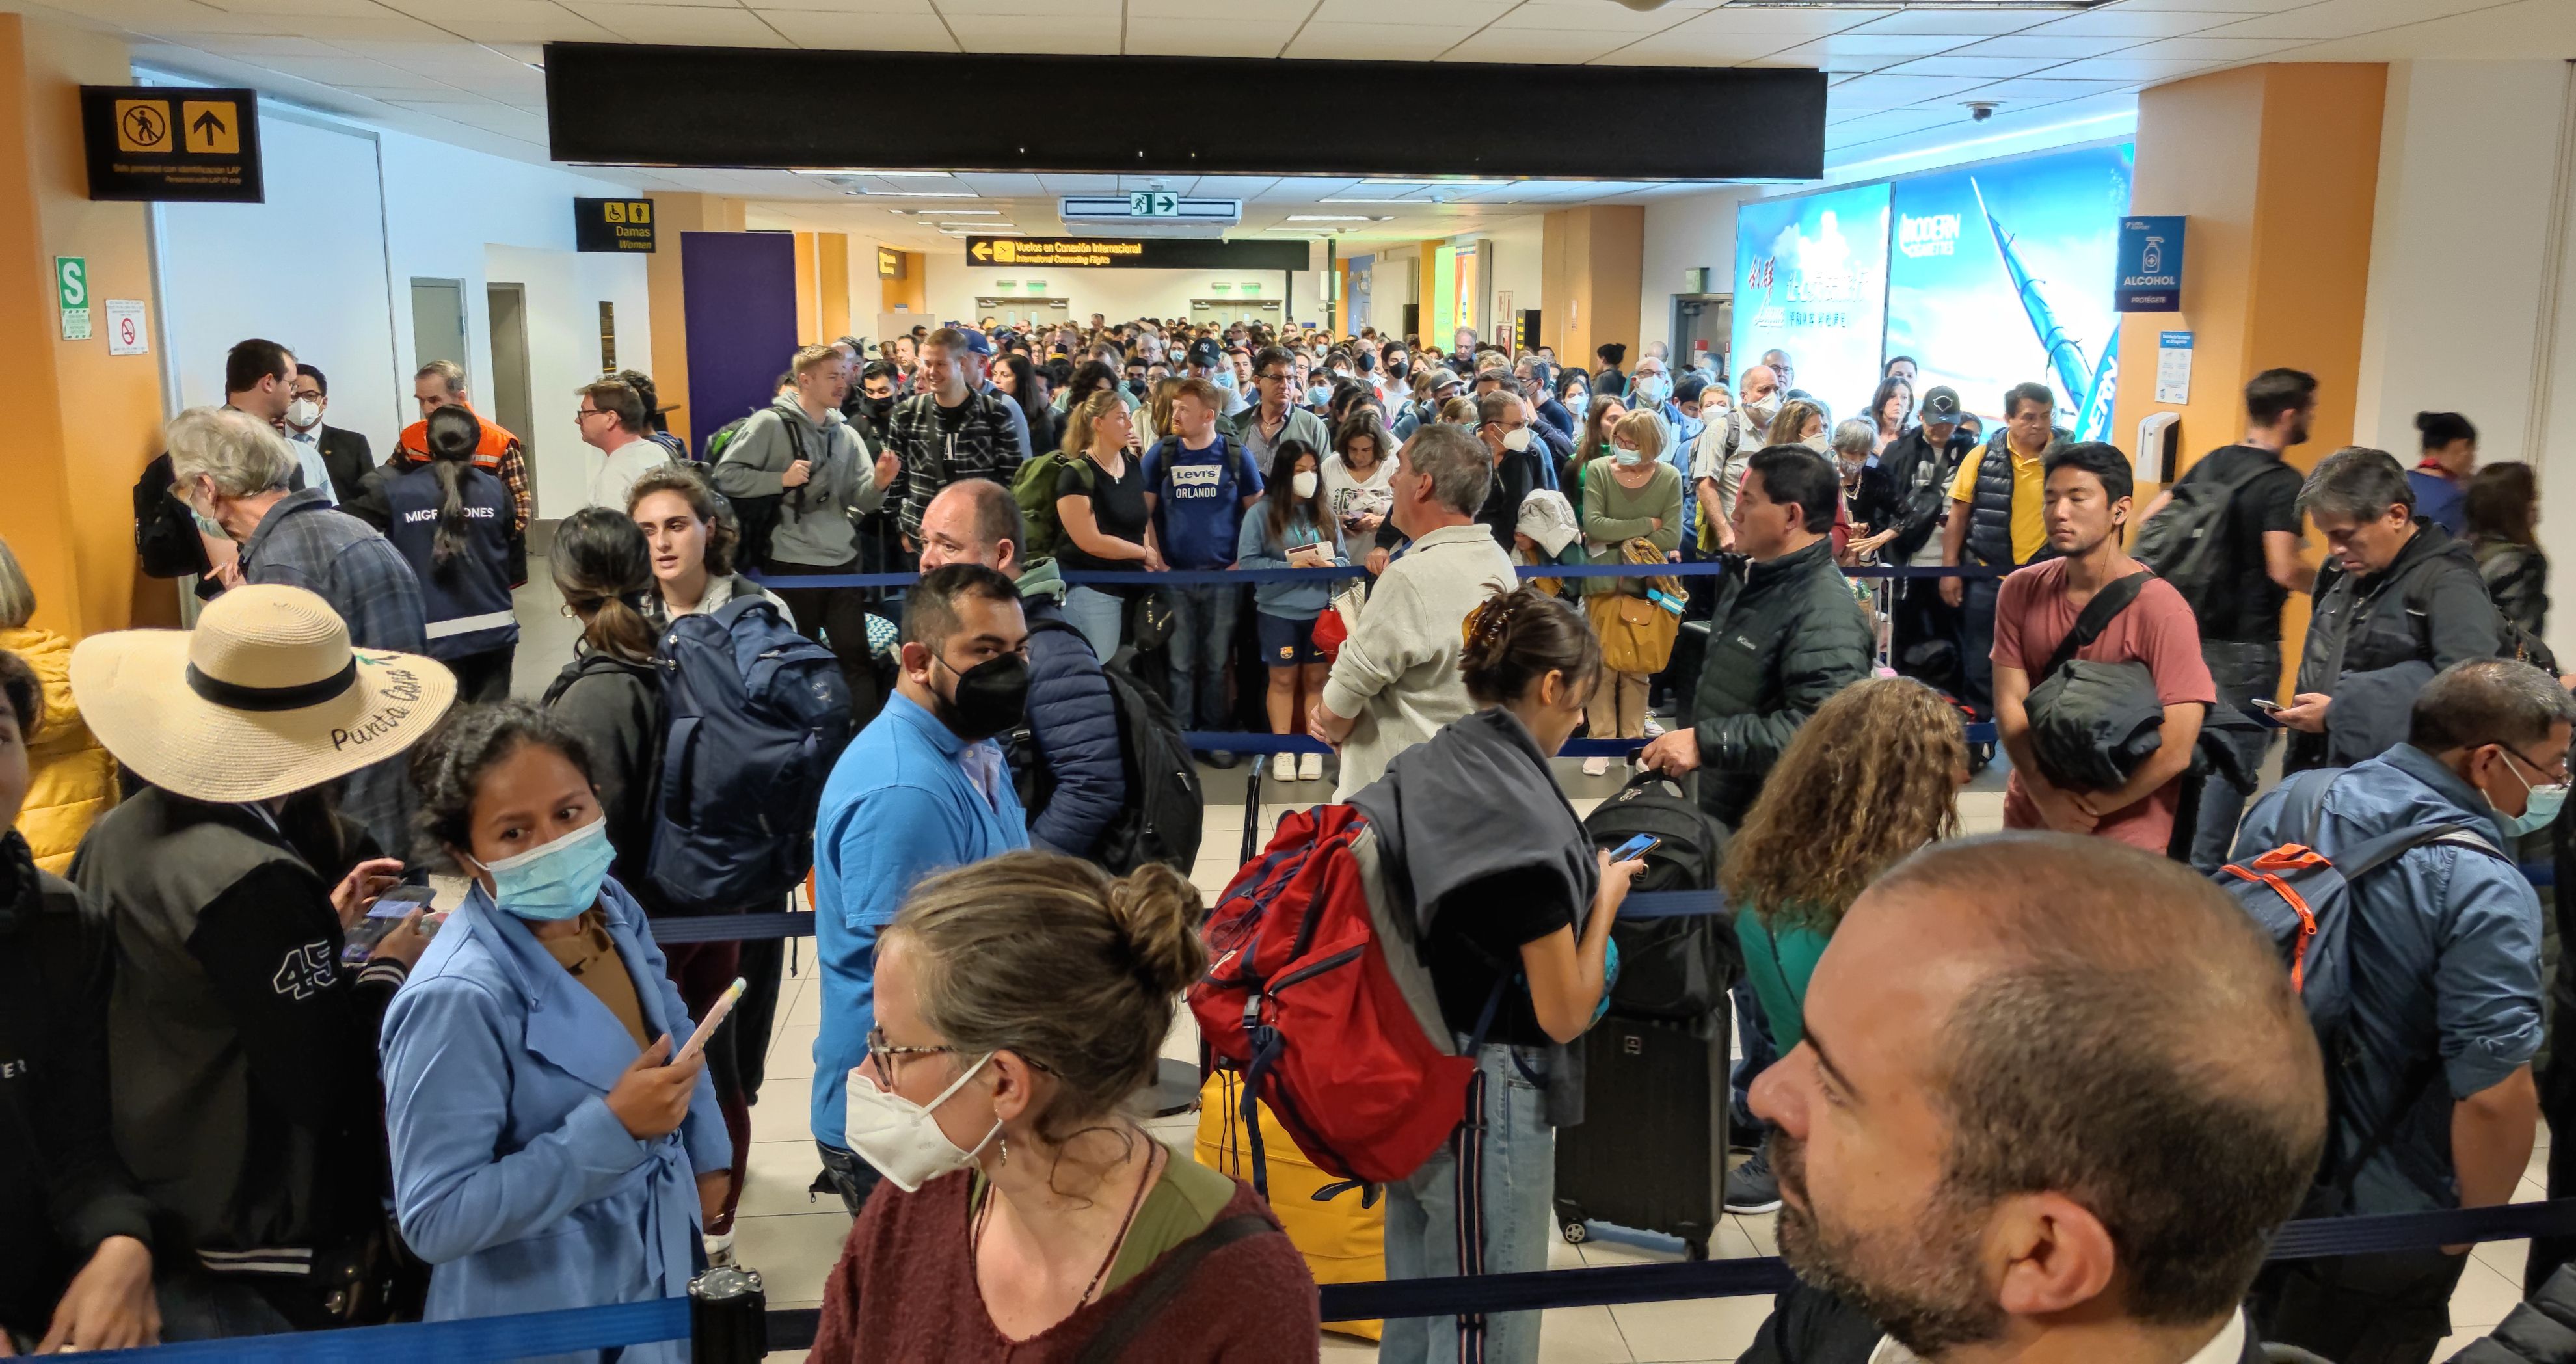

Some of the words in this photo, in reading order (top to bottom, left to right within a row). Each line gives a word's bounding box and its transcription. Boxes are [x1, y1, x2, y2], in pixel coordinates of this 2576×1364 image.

[616, 226, 651, 237] Damas
[619, 240, 651, 249] Women
[1015, 242, 1042, 253] Vuelos
[1043, 244, 1054, 253] en
[1054, 242, 1092, 253] Conexión
[1092, 243, 1142, 254] Internacional
[1015, 254, 1054, 263] International
[1054, 255, 1089, 265] Connecting
[1089, 255, 1110, 265] Flights
[62, 261, 85, 305] S
[2123, 276, 2175, 286] ALCOHOL
[1175, 487, 1216, 499] ORLANDO
[405, 507, 494, 523] MIGRONES
[331, 707, 410, 752] Punta
[273, 939, 338, 1000] 45
